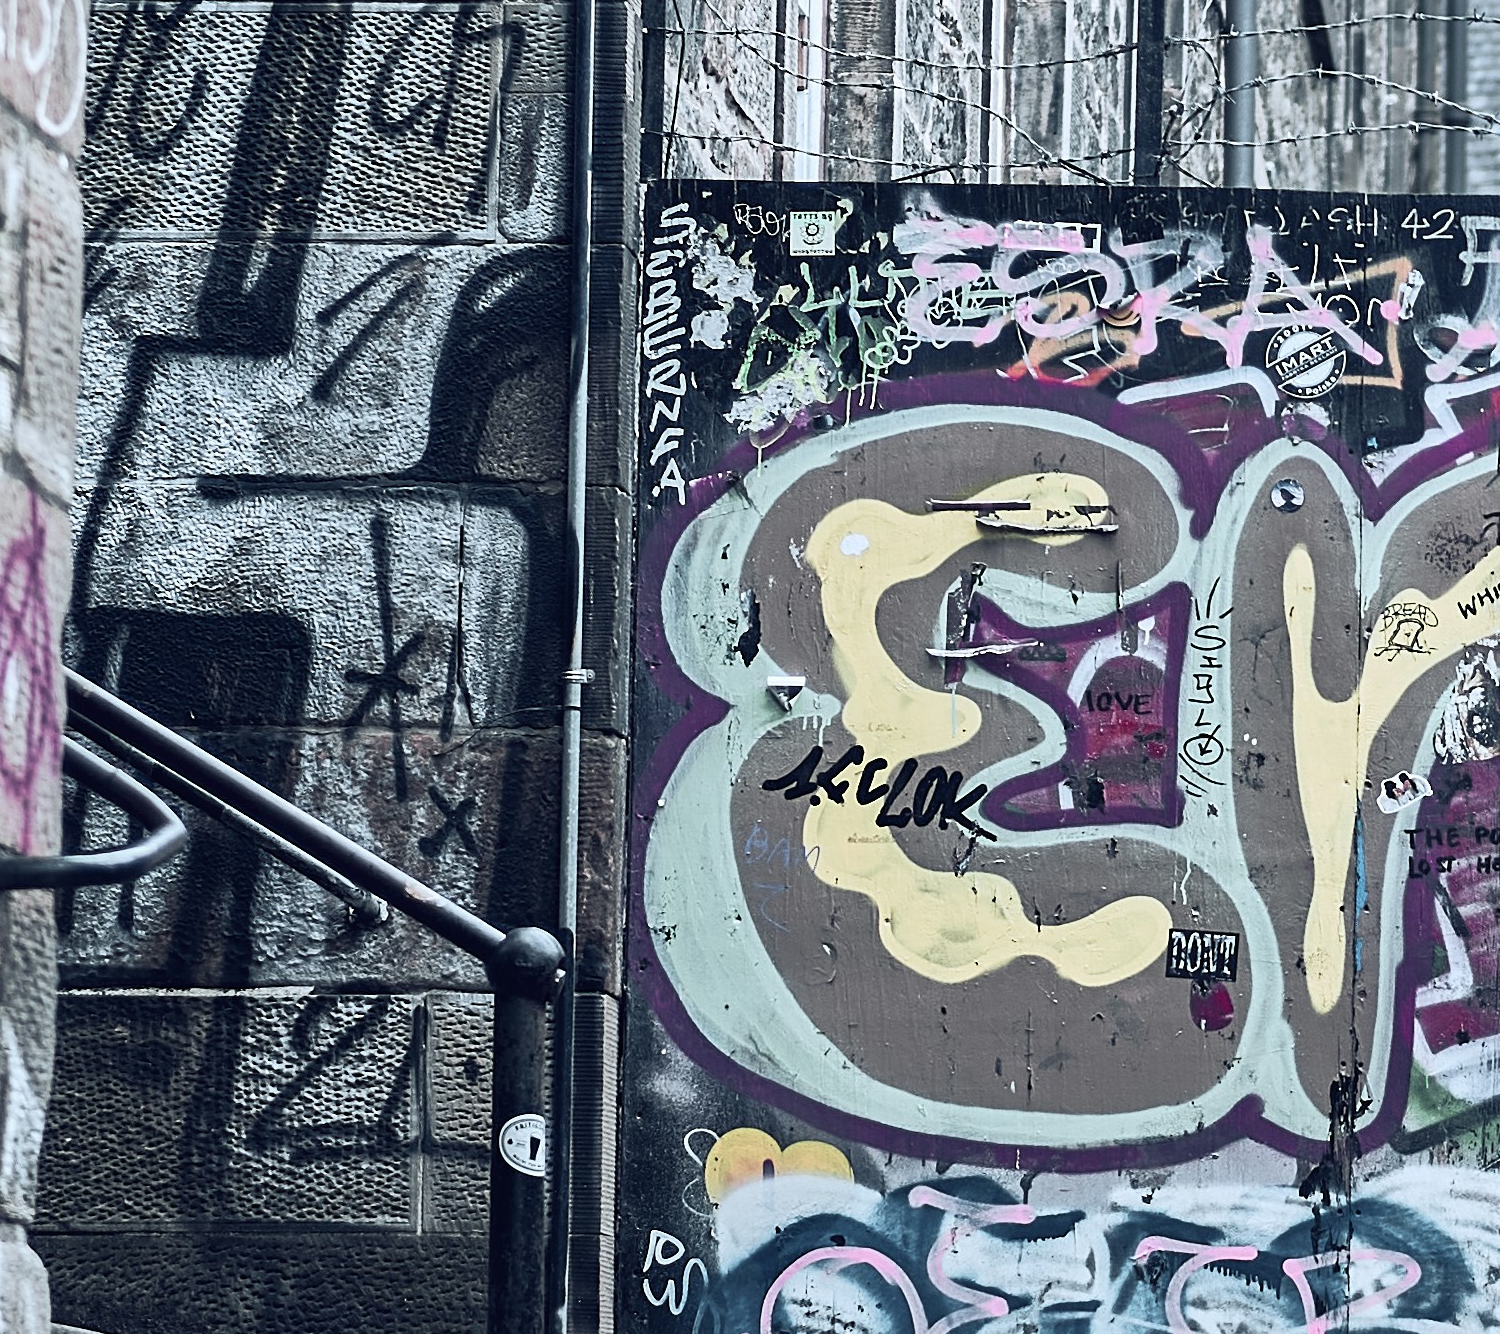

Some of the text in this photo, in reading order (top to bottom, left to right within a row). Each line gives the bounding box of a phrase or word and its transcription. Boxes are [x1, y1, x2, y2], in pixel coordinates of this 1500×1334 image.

[1399, 207, 1456, 240] 42
[1274, 337, 1336, 376] IMART
[1379, 602, 1439, 631] BREAD
[1403, 827, 1461, 850] THE
